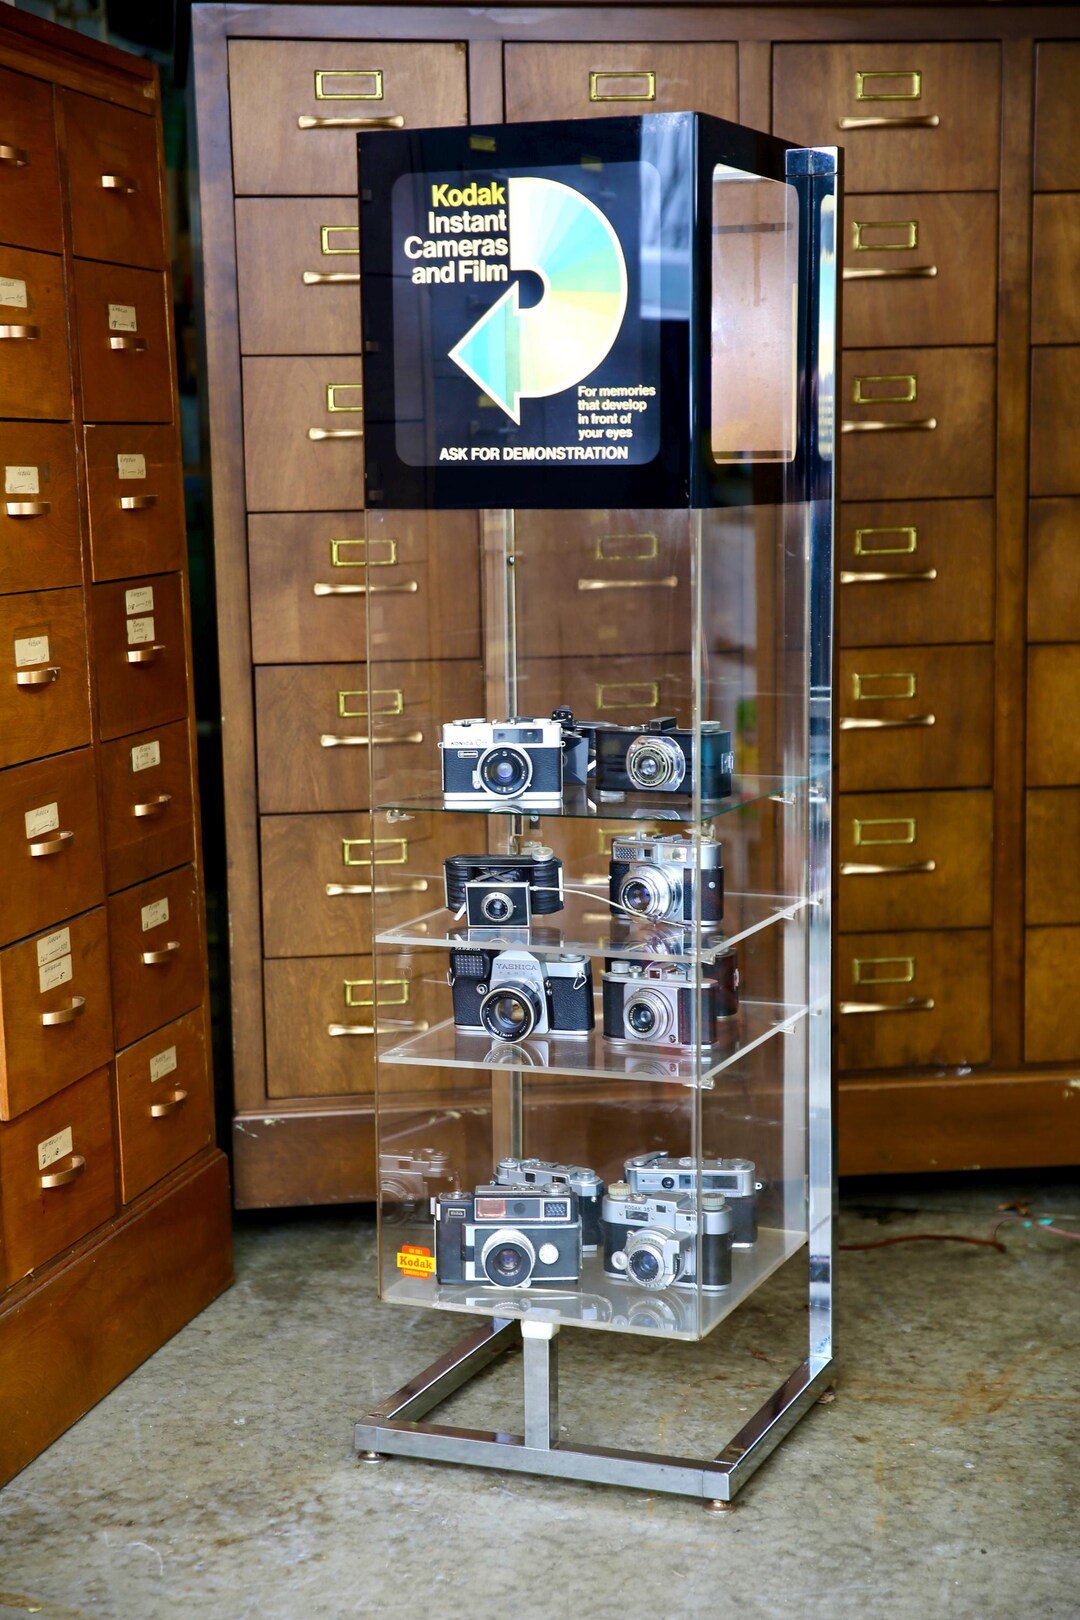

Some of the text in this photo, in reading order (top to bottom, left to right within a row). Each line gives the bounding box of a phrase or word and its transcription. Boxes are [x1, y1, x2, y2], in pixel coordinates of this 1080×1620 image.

[432, 182, 506, 208] Kodak
[428, 209, 507, 234] Instant
[404, 236, 509, 259] Cameras
[411, 259, 508, 284] and Film
[577, 384, 656, 397] For memories
[577, 399, 647, 412] that develop
[577, 413, 632, 424] in front of
[578, 428, 633, 441] your eyes
[439, 446, 628, 460] ASK FOR DEMONSTRATION
[496, 963, 537, 971] YASHICA
[399, 1255, 433, 1270] Kodak
